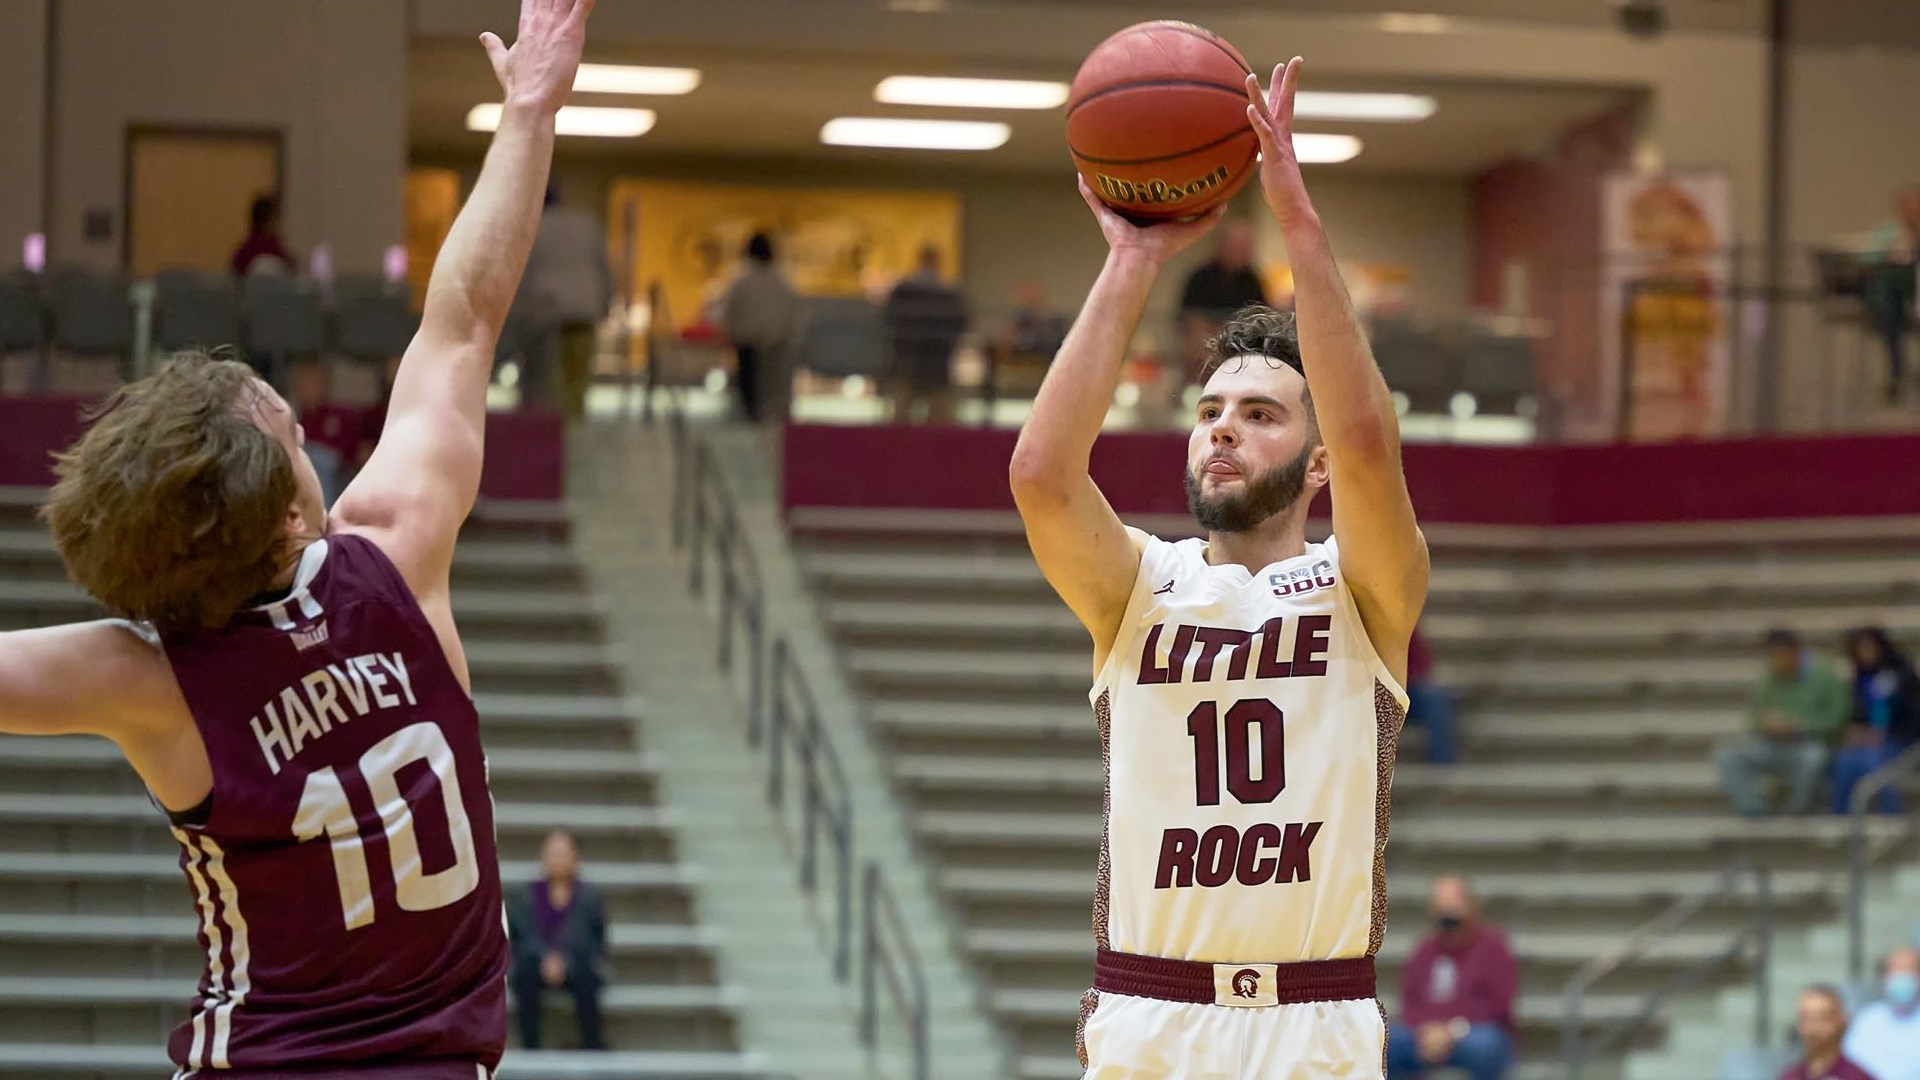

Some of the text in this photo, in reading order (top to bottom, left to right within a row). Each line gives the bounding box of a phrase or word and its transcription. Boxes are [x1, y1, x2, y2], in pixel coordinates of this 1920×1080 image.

[1096, 165, 1228, 203] Wilson
[1269, 560, 1336, 596] SBC
[1137, 615, 1332, 685] LITTLE
[250, 651, 417, 775] HARVEY
[1187, 698, 1286, 806] 10
[291, 721, 479, 931] 10
[1154, 821, 1324, 889] ROCK
